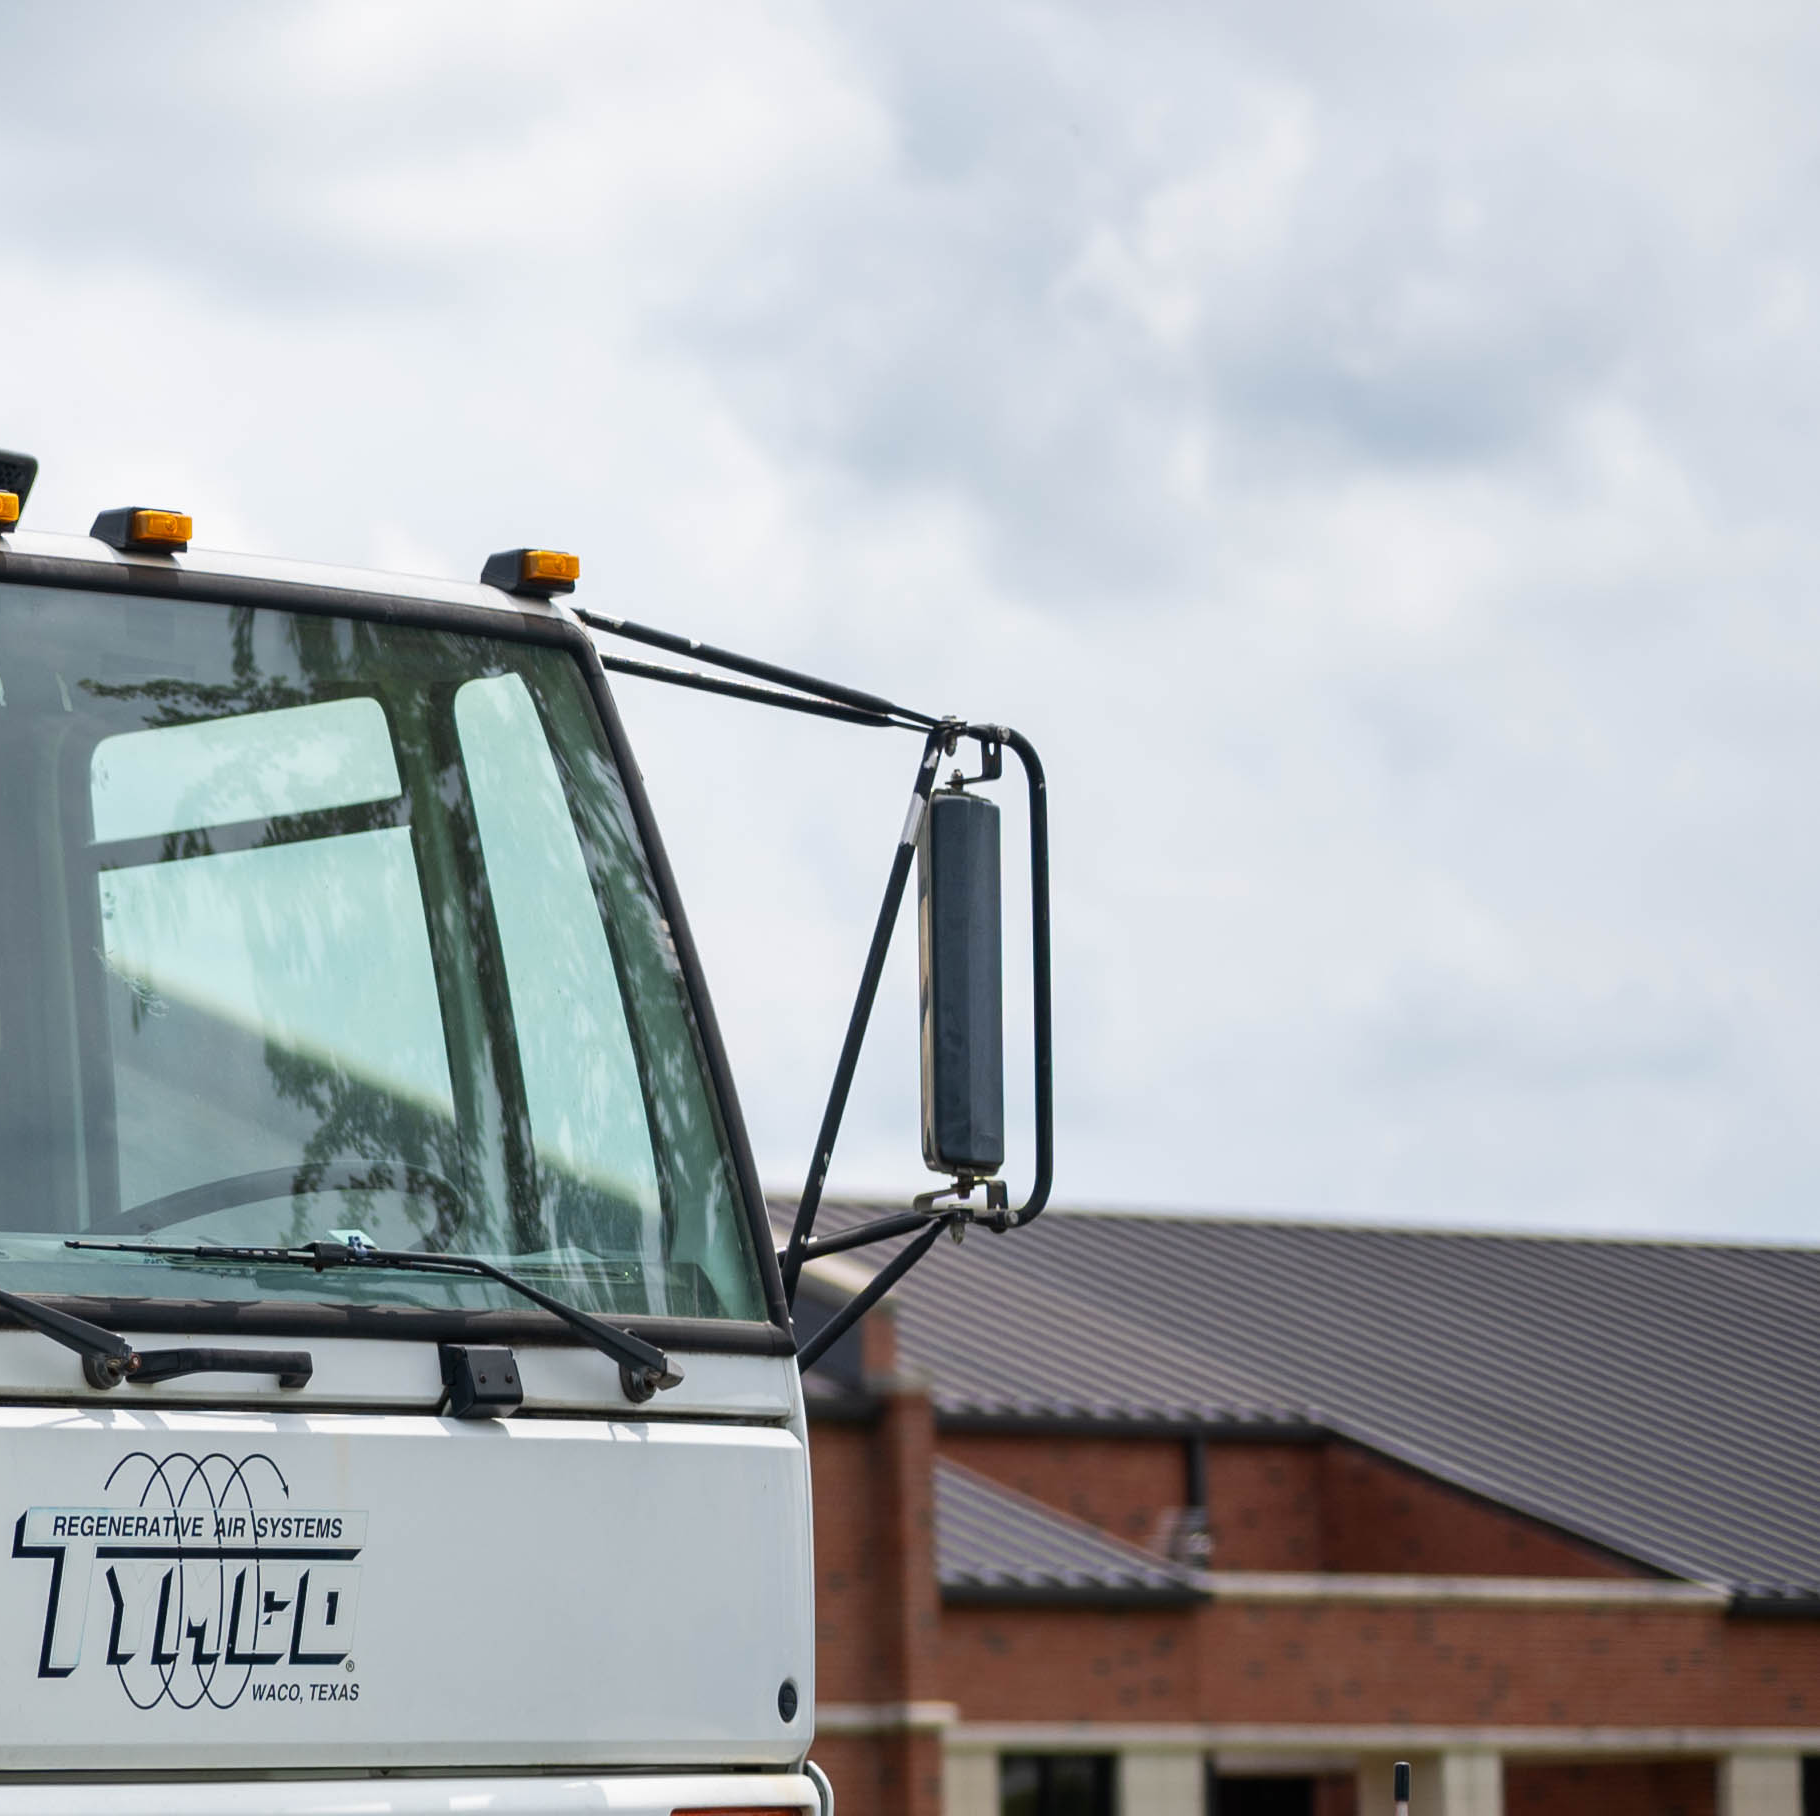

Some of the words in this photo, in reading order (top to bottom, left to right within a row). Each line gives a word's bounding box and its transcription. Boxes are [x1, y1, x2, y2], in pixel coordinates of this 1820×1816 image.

[53, 1516, 204, 1539] REGENERATIVE
[214, 1517, 246, 1539] AIR
[256, 1517, 343, 1540] SYSTEMS
[12, 1508, 368, 1678] TYMCO
[251, 1683, 304, 1703] WACO,
[309, 1683, 360, 1702] TEXAS
